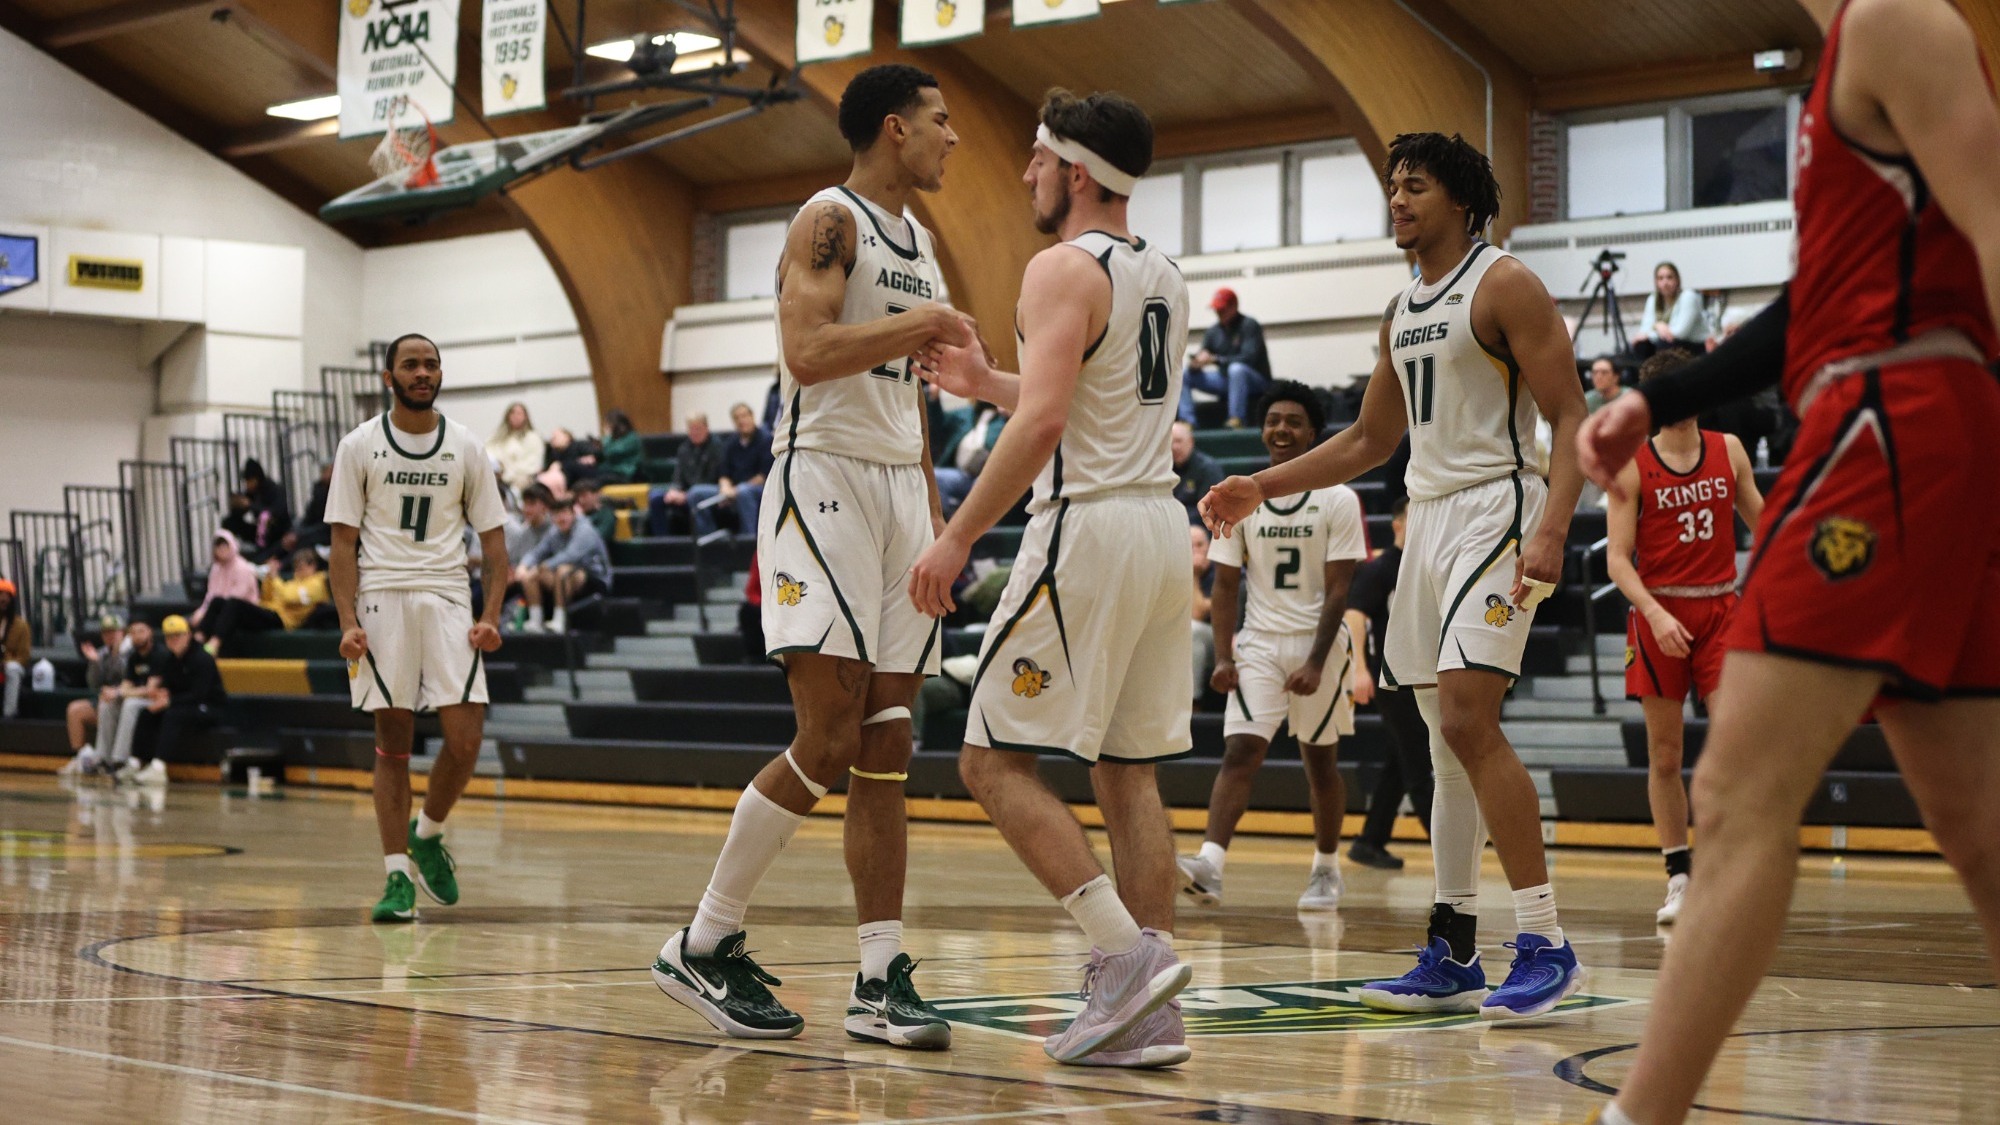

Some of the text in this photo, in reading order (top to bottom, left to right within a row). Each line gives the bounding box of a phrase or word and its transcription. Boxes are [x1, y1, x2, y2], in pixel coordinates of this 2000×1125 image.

[363, 10, 428, 54] NCAA
[495, 38, 531, 65] 1995
[875, 267, 932, 299] AGGIES
[1136, 296, 1172, 406] 0
[1393, 321, 1449, 351] AGGIES
[1403, 353, 1436, 429] 11
[383, 471, 449, 486] AGGIES
[1654, 477, 1728, 510] KING'S
[399, 494, 433, 543] 4
[1256, 525, 1313, 538] AGGIES
[1677, 507, 1714, 543] 33
[1273, 546, 1301, 590] 2
